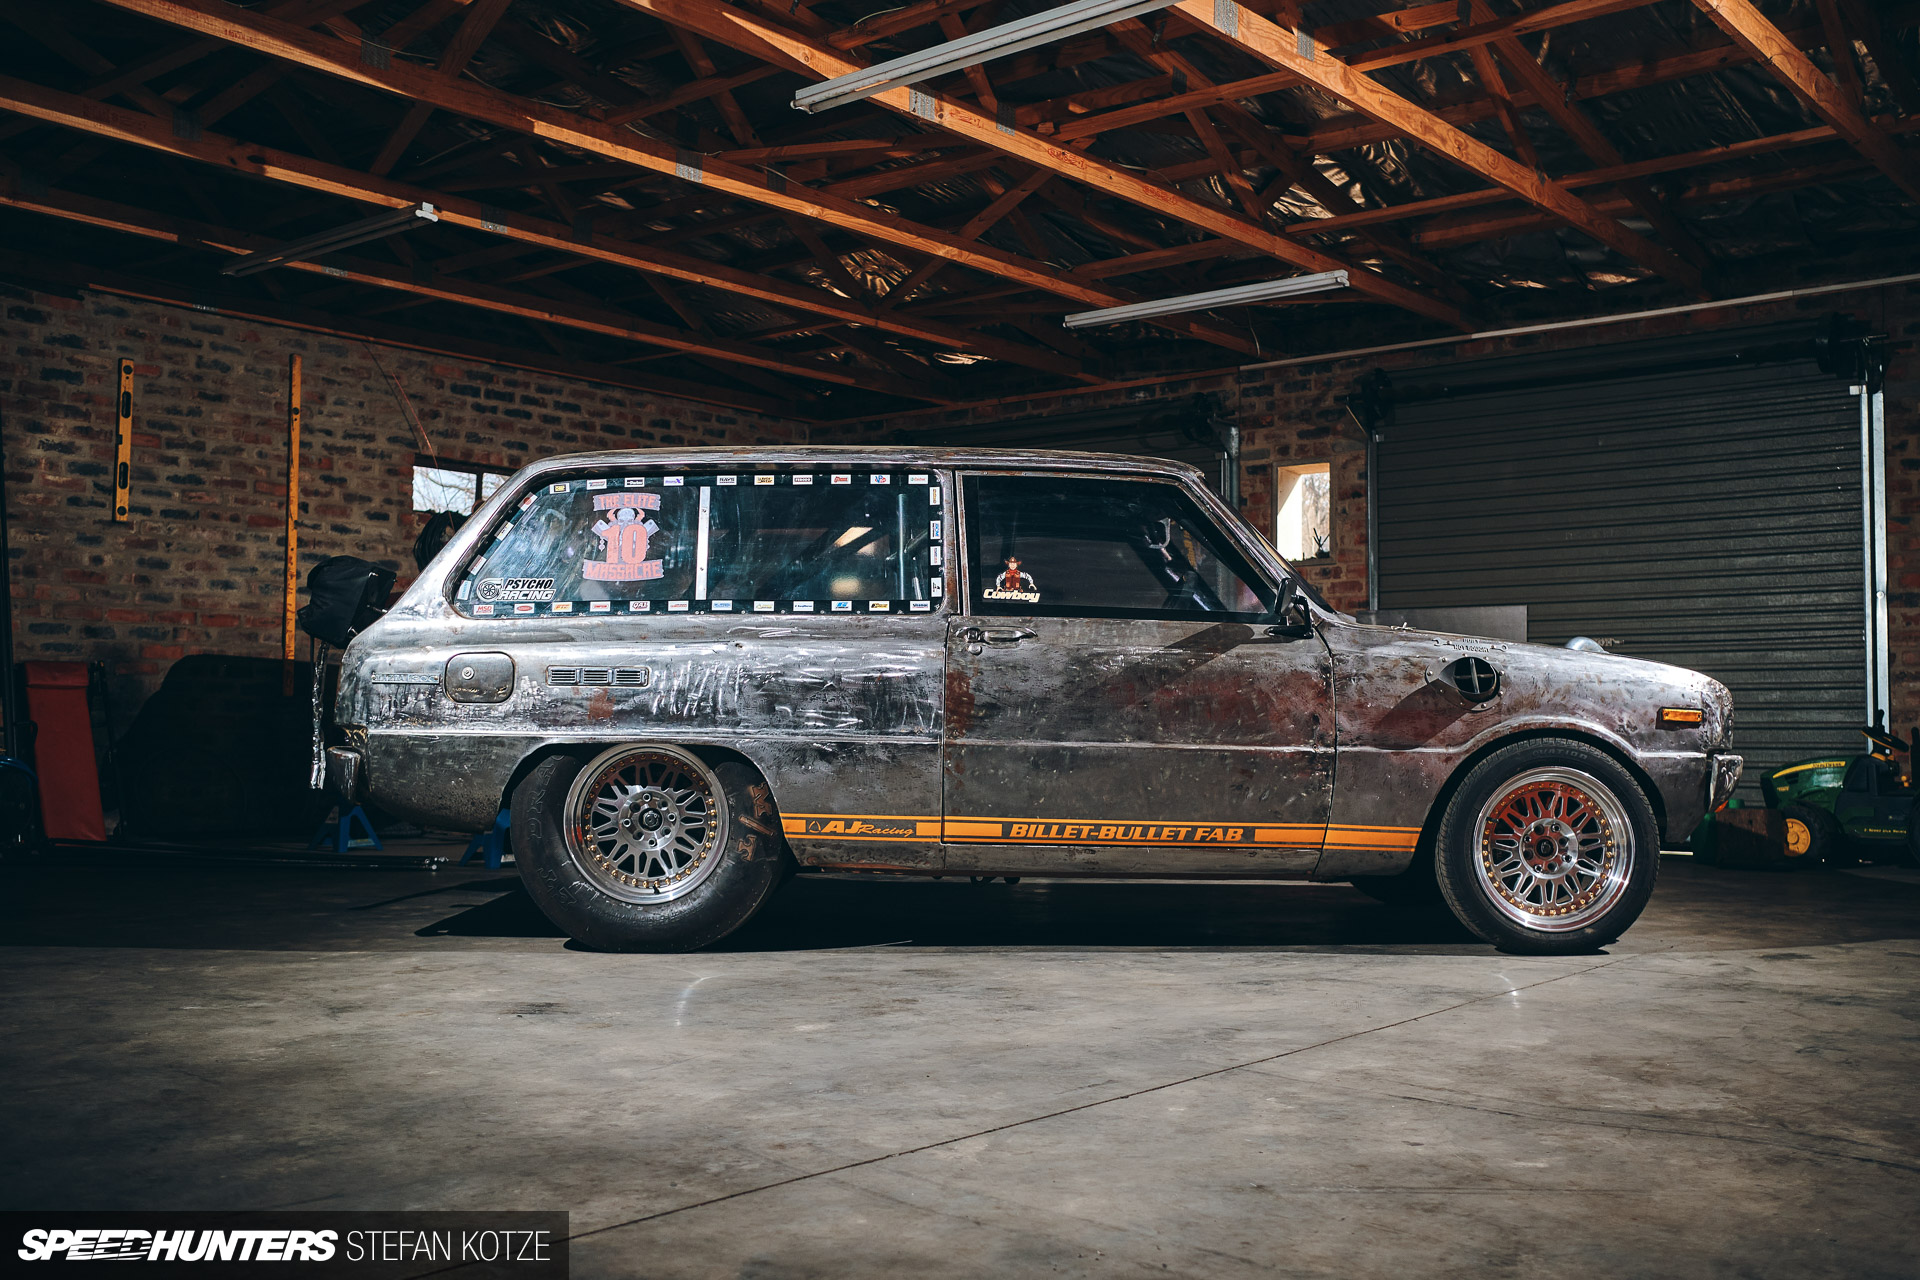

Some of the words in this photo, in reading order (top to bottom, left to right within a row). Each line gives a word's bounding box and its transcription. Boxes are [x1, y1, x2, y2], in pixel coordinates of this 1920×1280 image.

[598, 495, 622, 509] THE
[623, 494, 657, 509] ELITE
[601, 524, 647, 564] 10
[586, 561, 663, 580] MASSACRE
[505, 578, 554, 590] PSYCHO
[498, 588, 556, 601] RACING
[983, 588, 1041, 603] Cowboy
[527, 754, 565, 840] DRA
[820, 820, 862, 834] AJ
[858, 825, 914, 838] Racing
[1009, 823, 1192, 842] BILLET-BULLET
[1193, 827, 1244, 842] FAB
